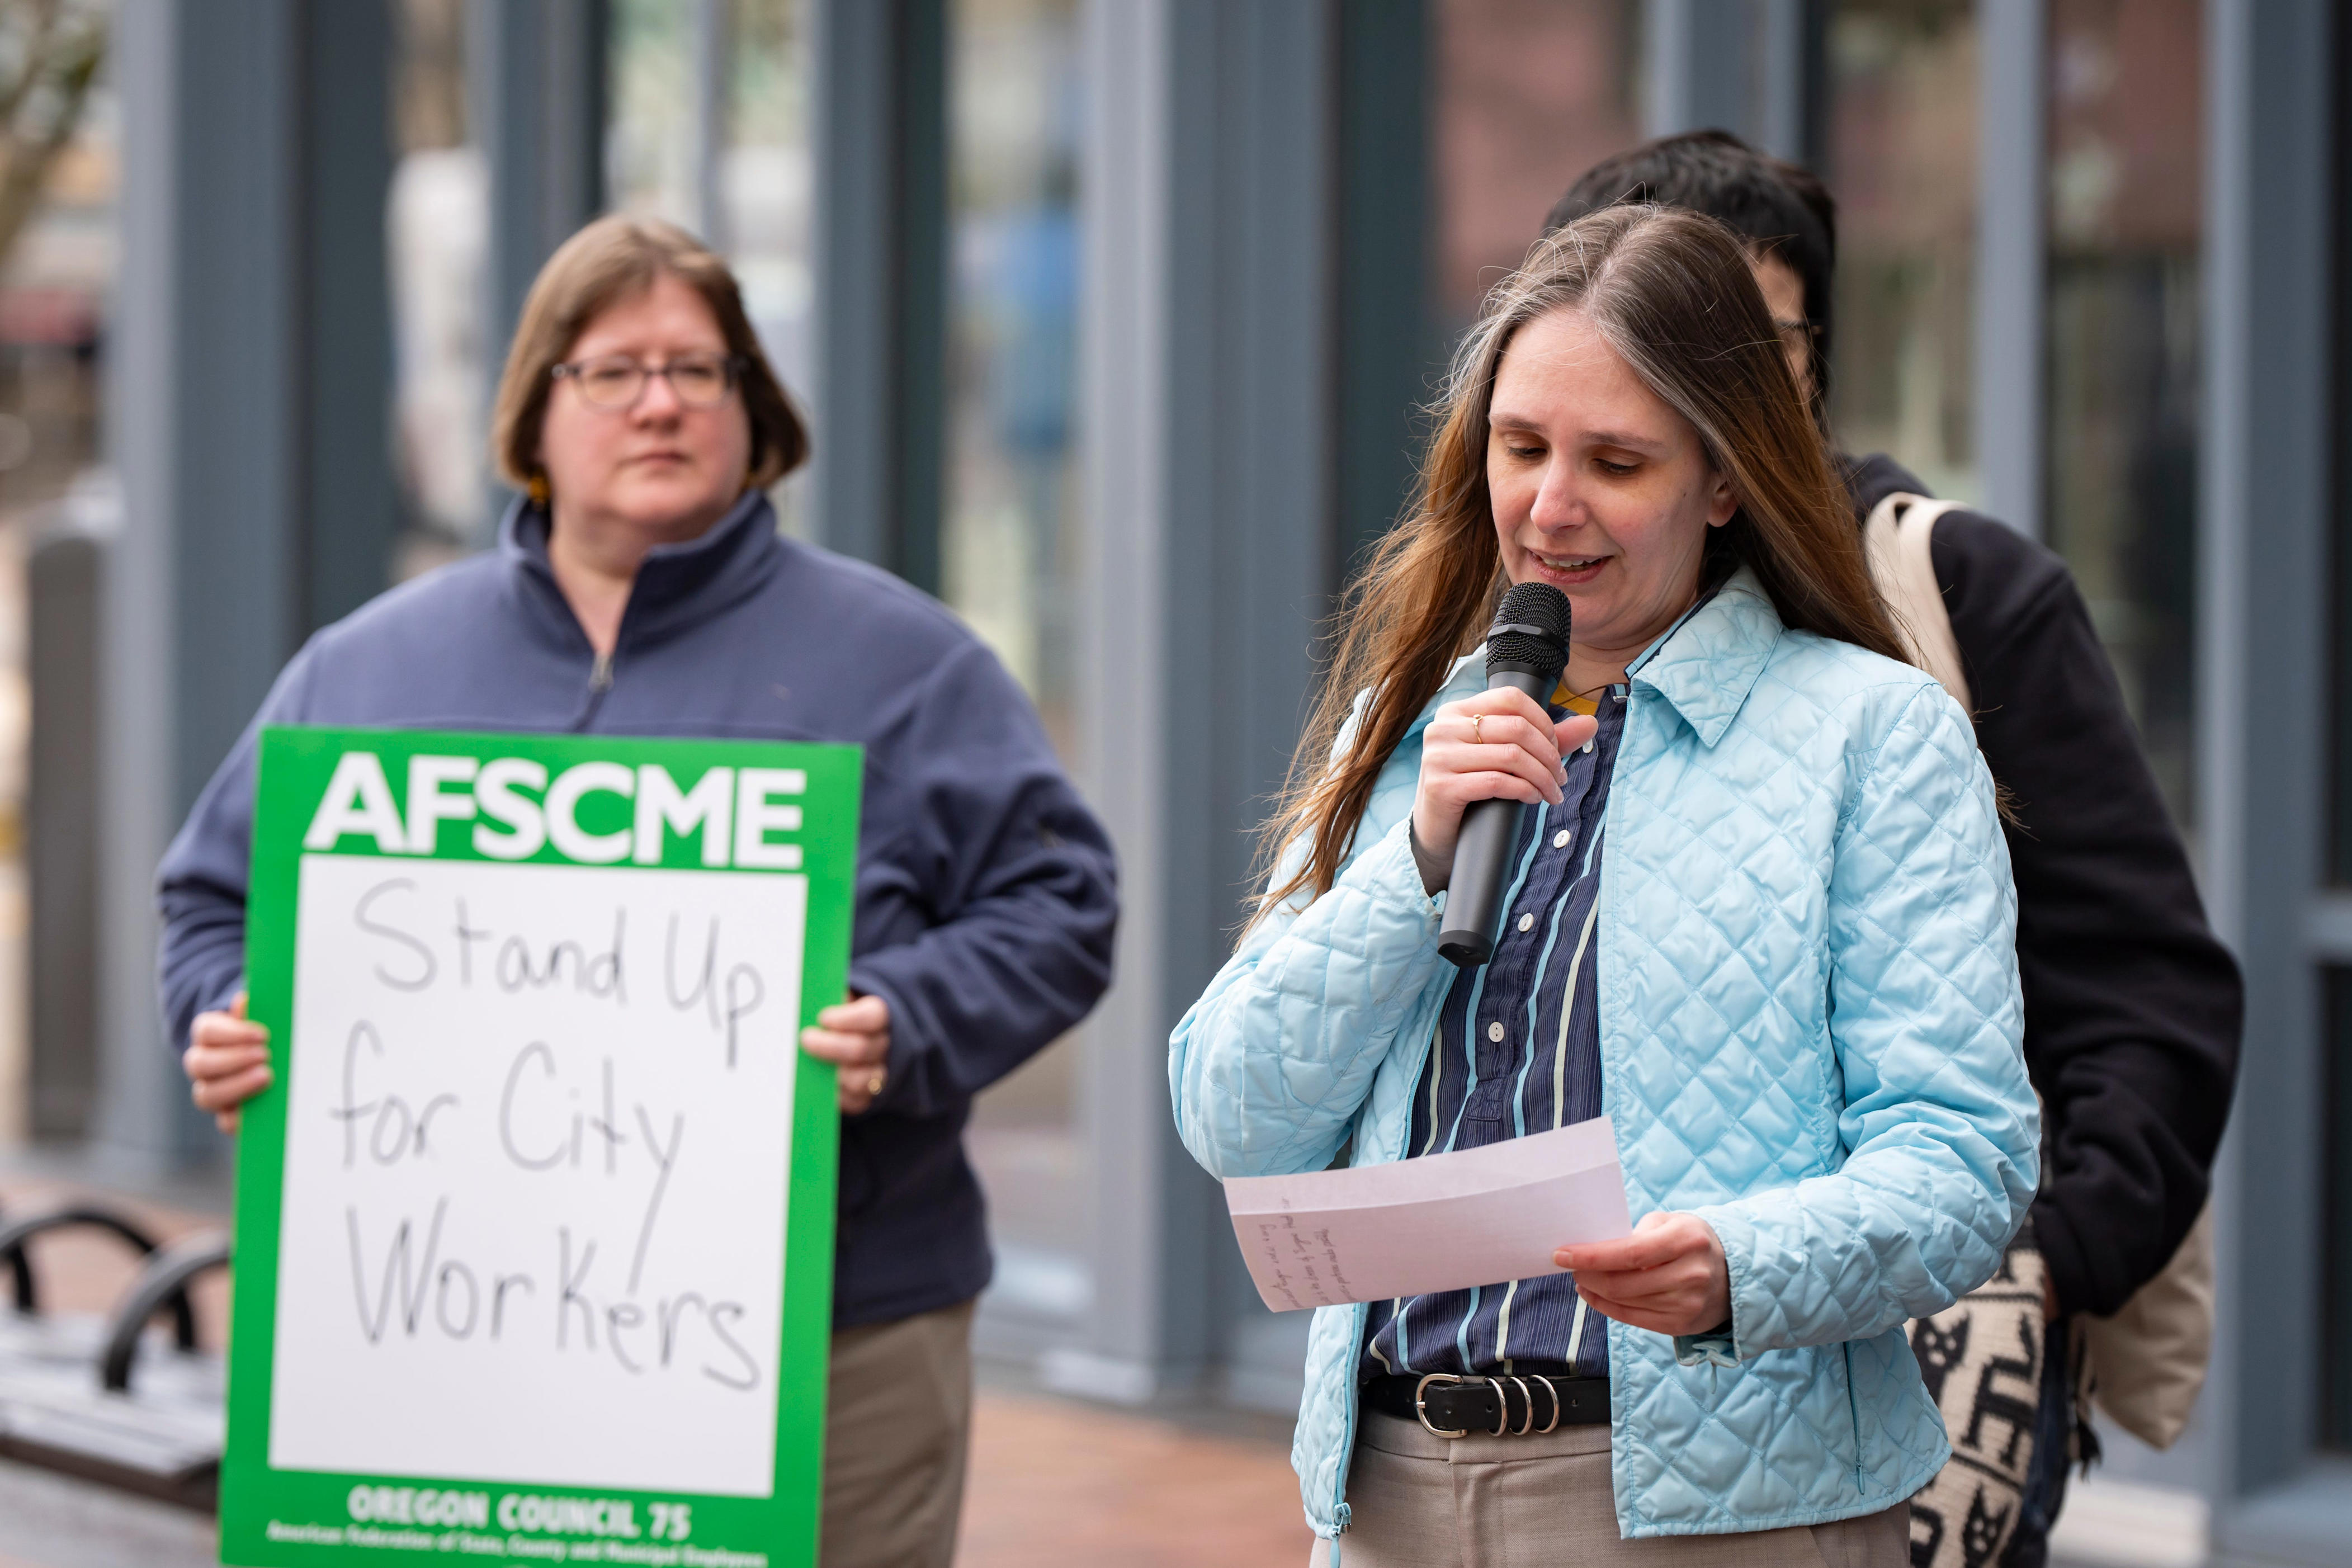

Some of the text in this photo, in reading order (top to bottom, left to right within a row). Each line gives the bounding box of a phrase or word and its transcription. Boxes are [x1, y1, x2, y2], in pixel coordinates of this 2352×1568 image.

[303, 752, 807, 869] AFSCME
[353, 877, 766, 1070] Stand Up
[330, 1019, 686, 1296] for City
[346, 1196, 761, 1392] Workers
[348, 1485, 692, 1541] OREGON COUNCIL 75
